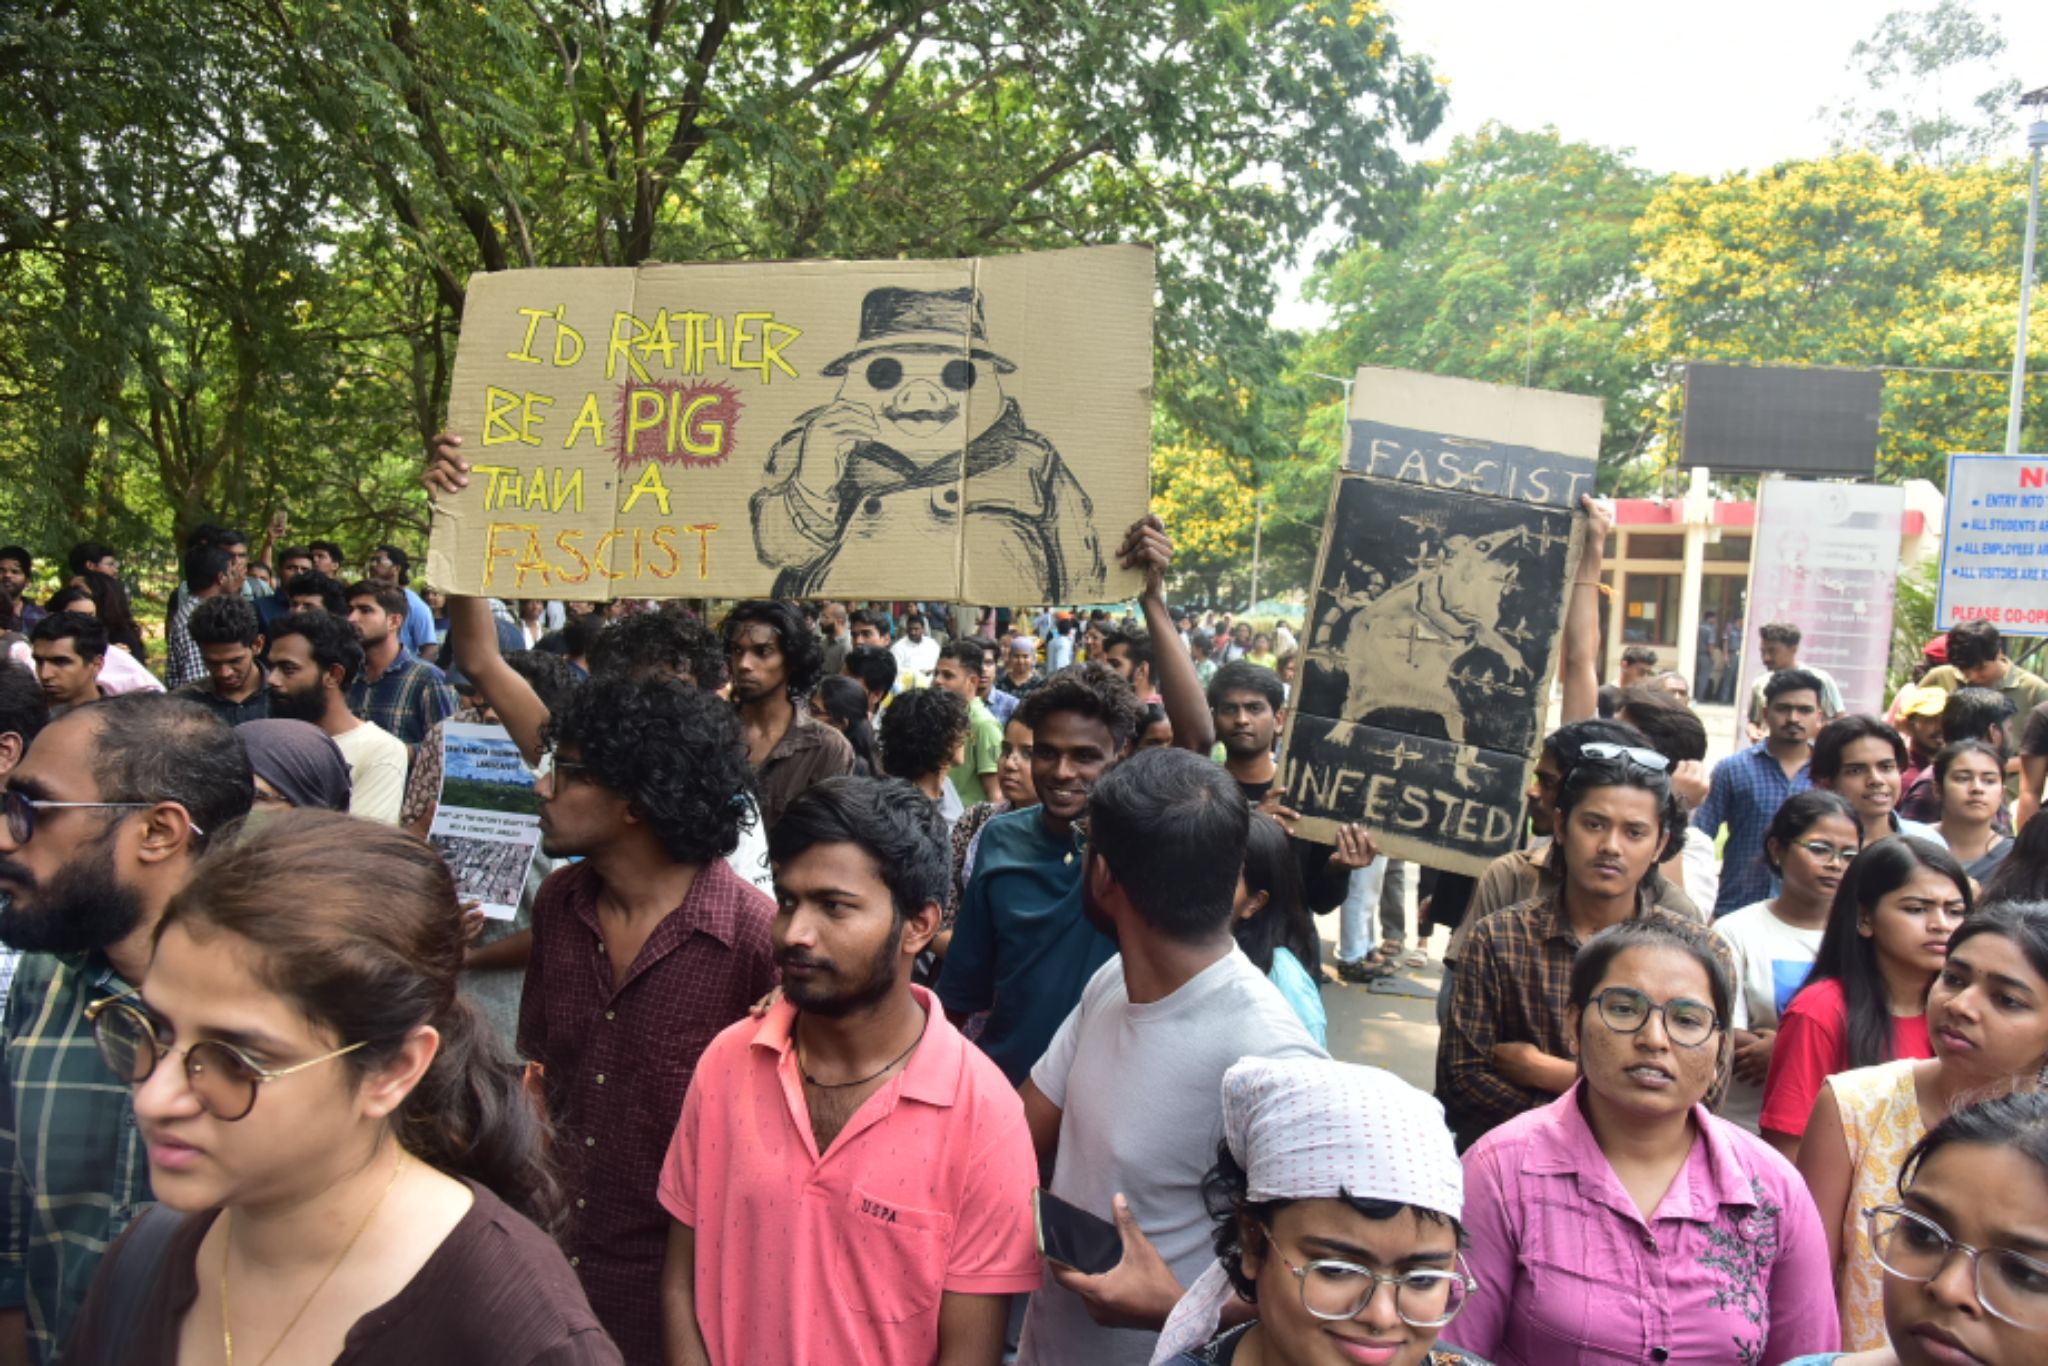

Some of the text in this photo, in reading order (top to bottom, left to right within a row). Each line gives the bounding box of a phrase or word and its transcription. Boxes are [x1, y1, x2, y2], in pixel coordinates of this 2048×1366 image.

[506, 303, 803, 384] I'D RATHER
[481, 385, 725, 456] BE A PIG
[620, 462, 671, 515] A
[1366, 438, 1592, 507] FASCIST
[2020, 466, 2048, 489] N
[1985, 494, 2017, 508] ENTRY
[2020, 495, 2045, 508] INTO
[1989, 518, 2035, 532] STUDENTS
[482, 522, 721, 588] FASCIST
[1952, 607, 2000, 623] PLEASE
[1285, 758, 1513, 843] INFESTED
[861, 1199, 897, 1222] USPA
